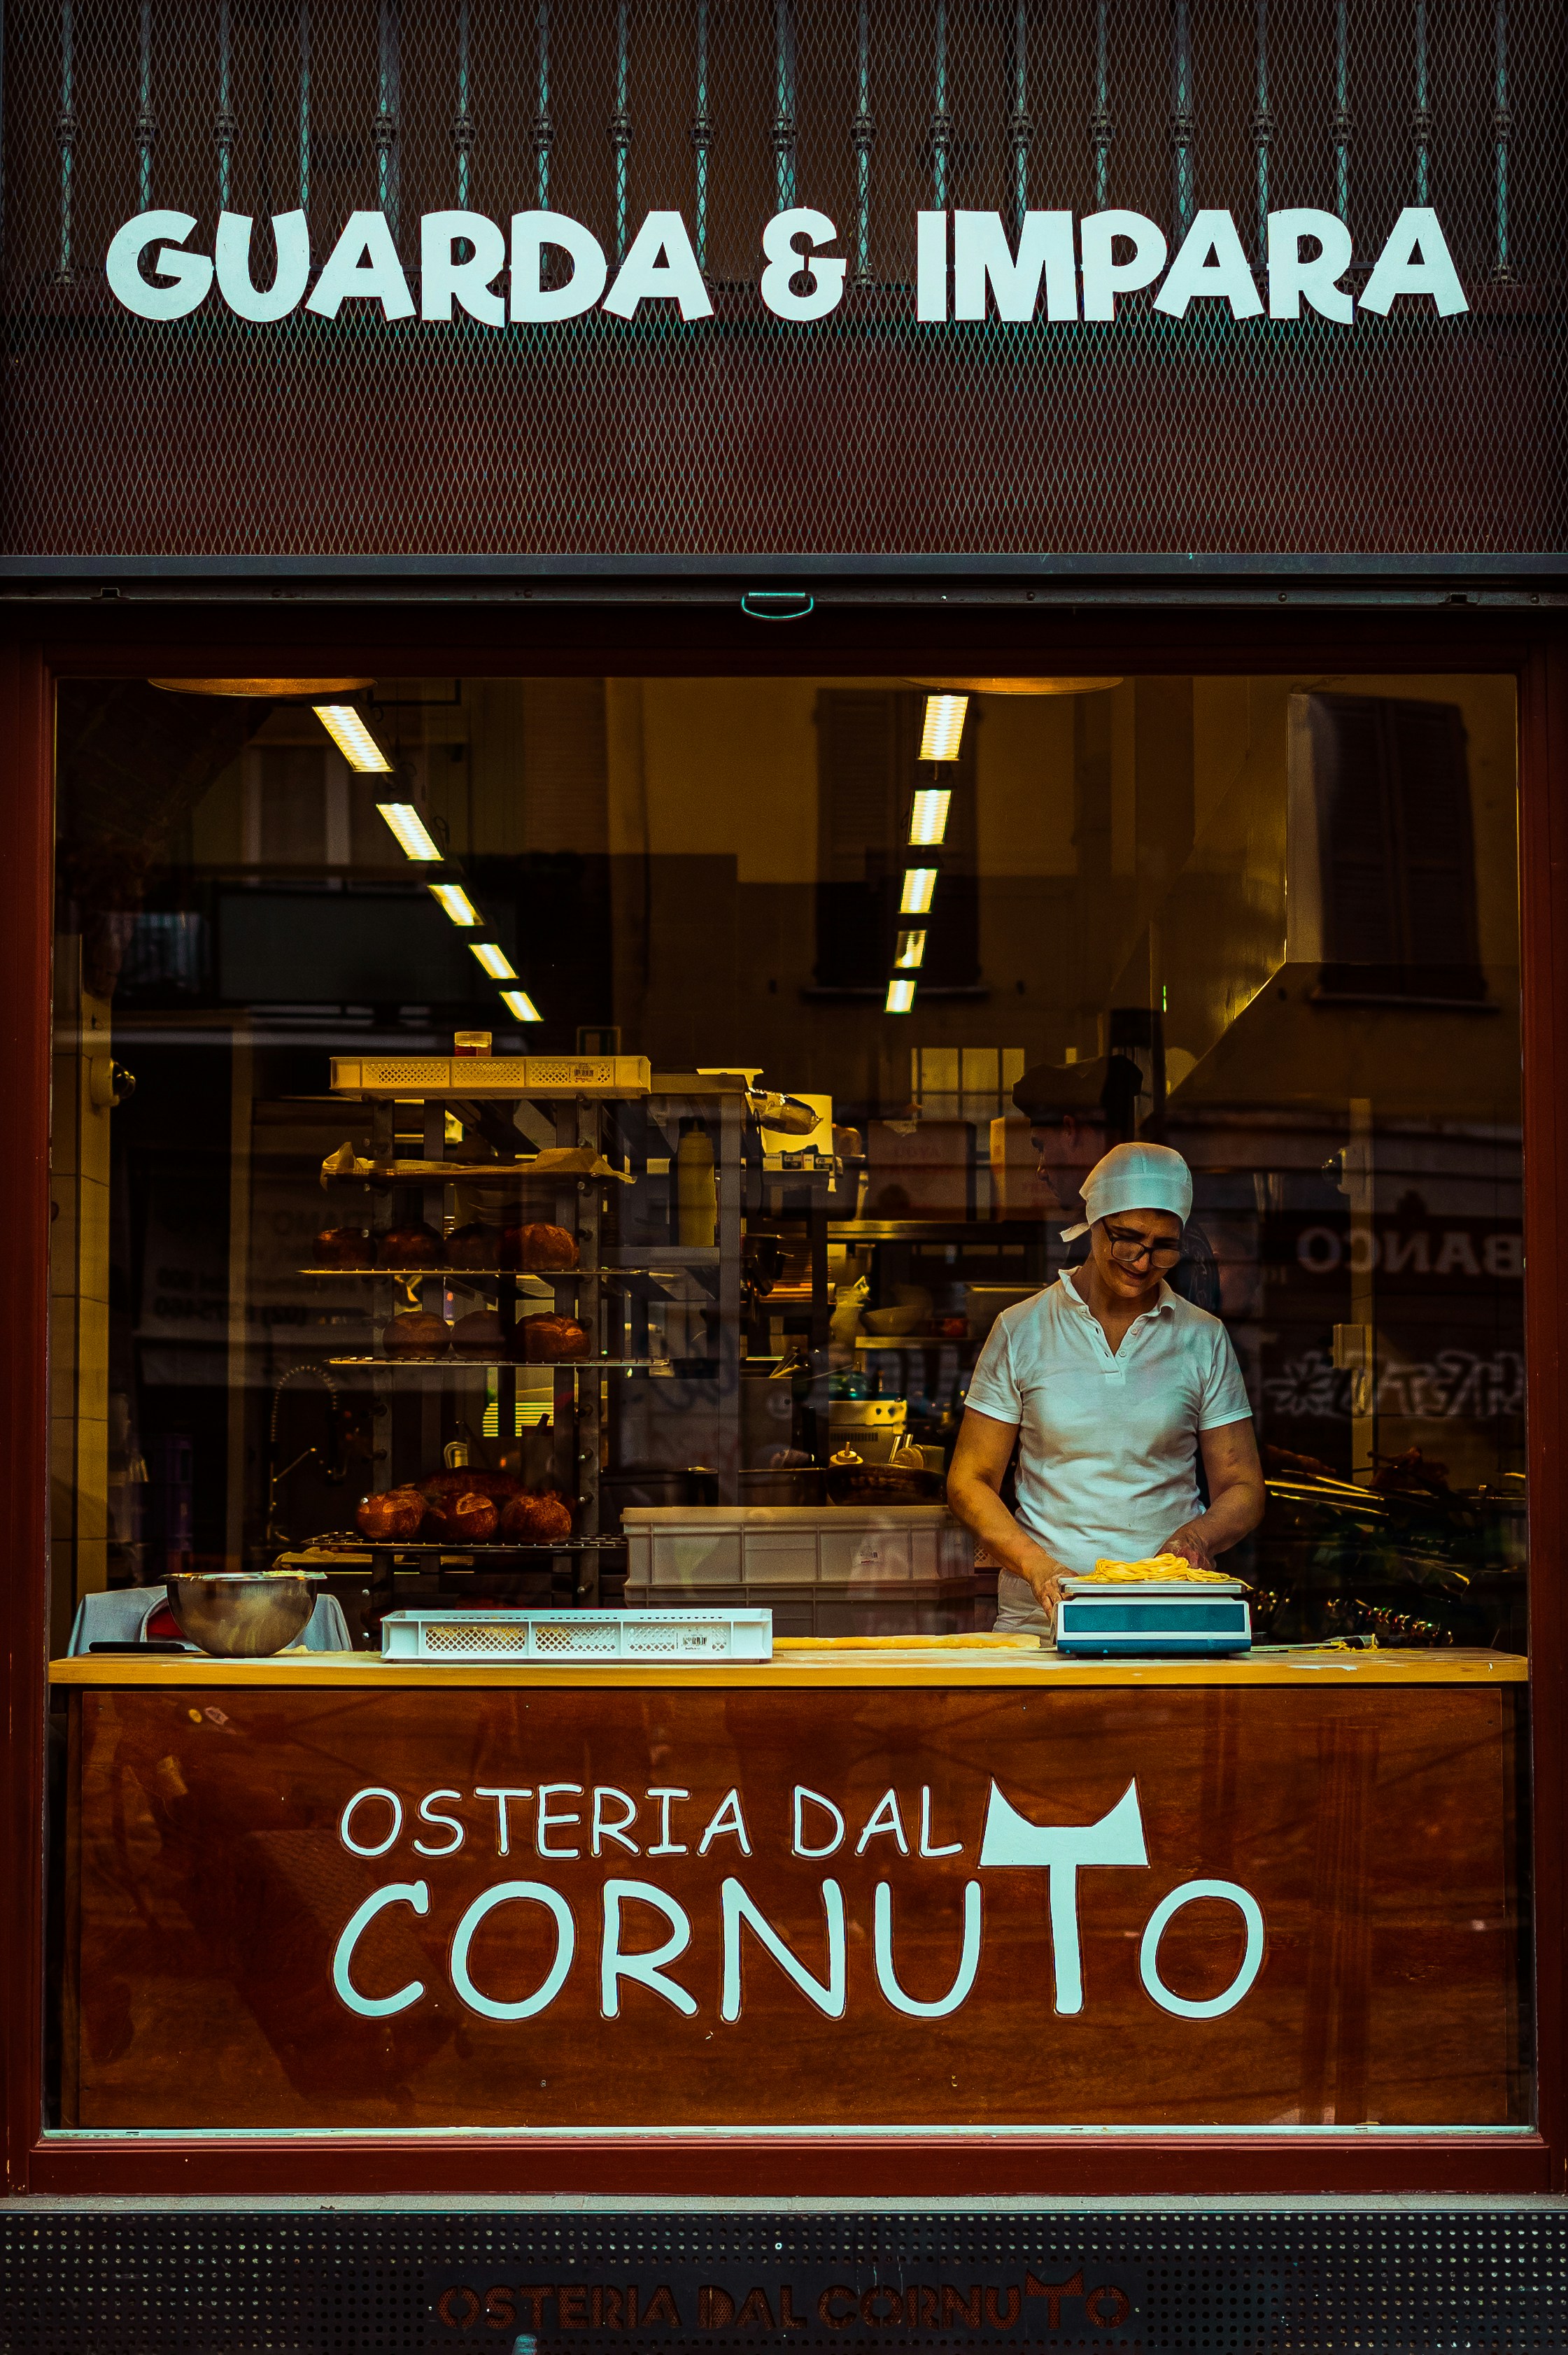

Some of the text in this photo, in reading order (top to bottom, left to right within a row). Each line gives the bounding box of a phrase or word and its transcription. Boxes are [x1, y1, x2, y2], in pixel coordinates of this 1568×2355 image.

[106, 206, 1470, 328] GUARDA & IMPARA
[339, 1782, 964, 1858] OSTERIA DAL
[332, 1776, 1266, 2021] CORNUTO
[437, 2267, 1131, 2331] OSTERIA DAL CORNUTO
